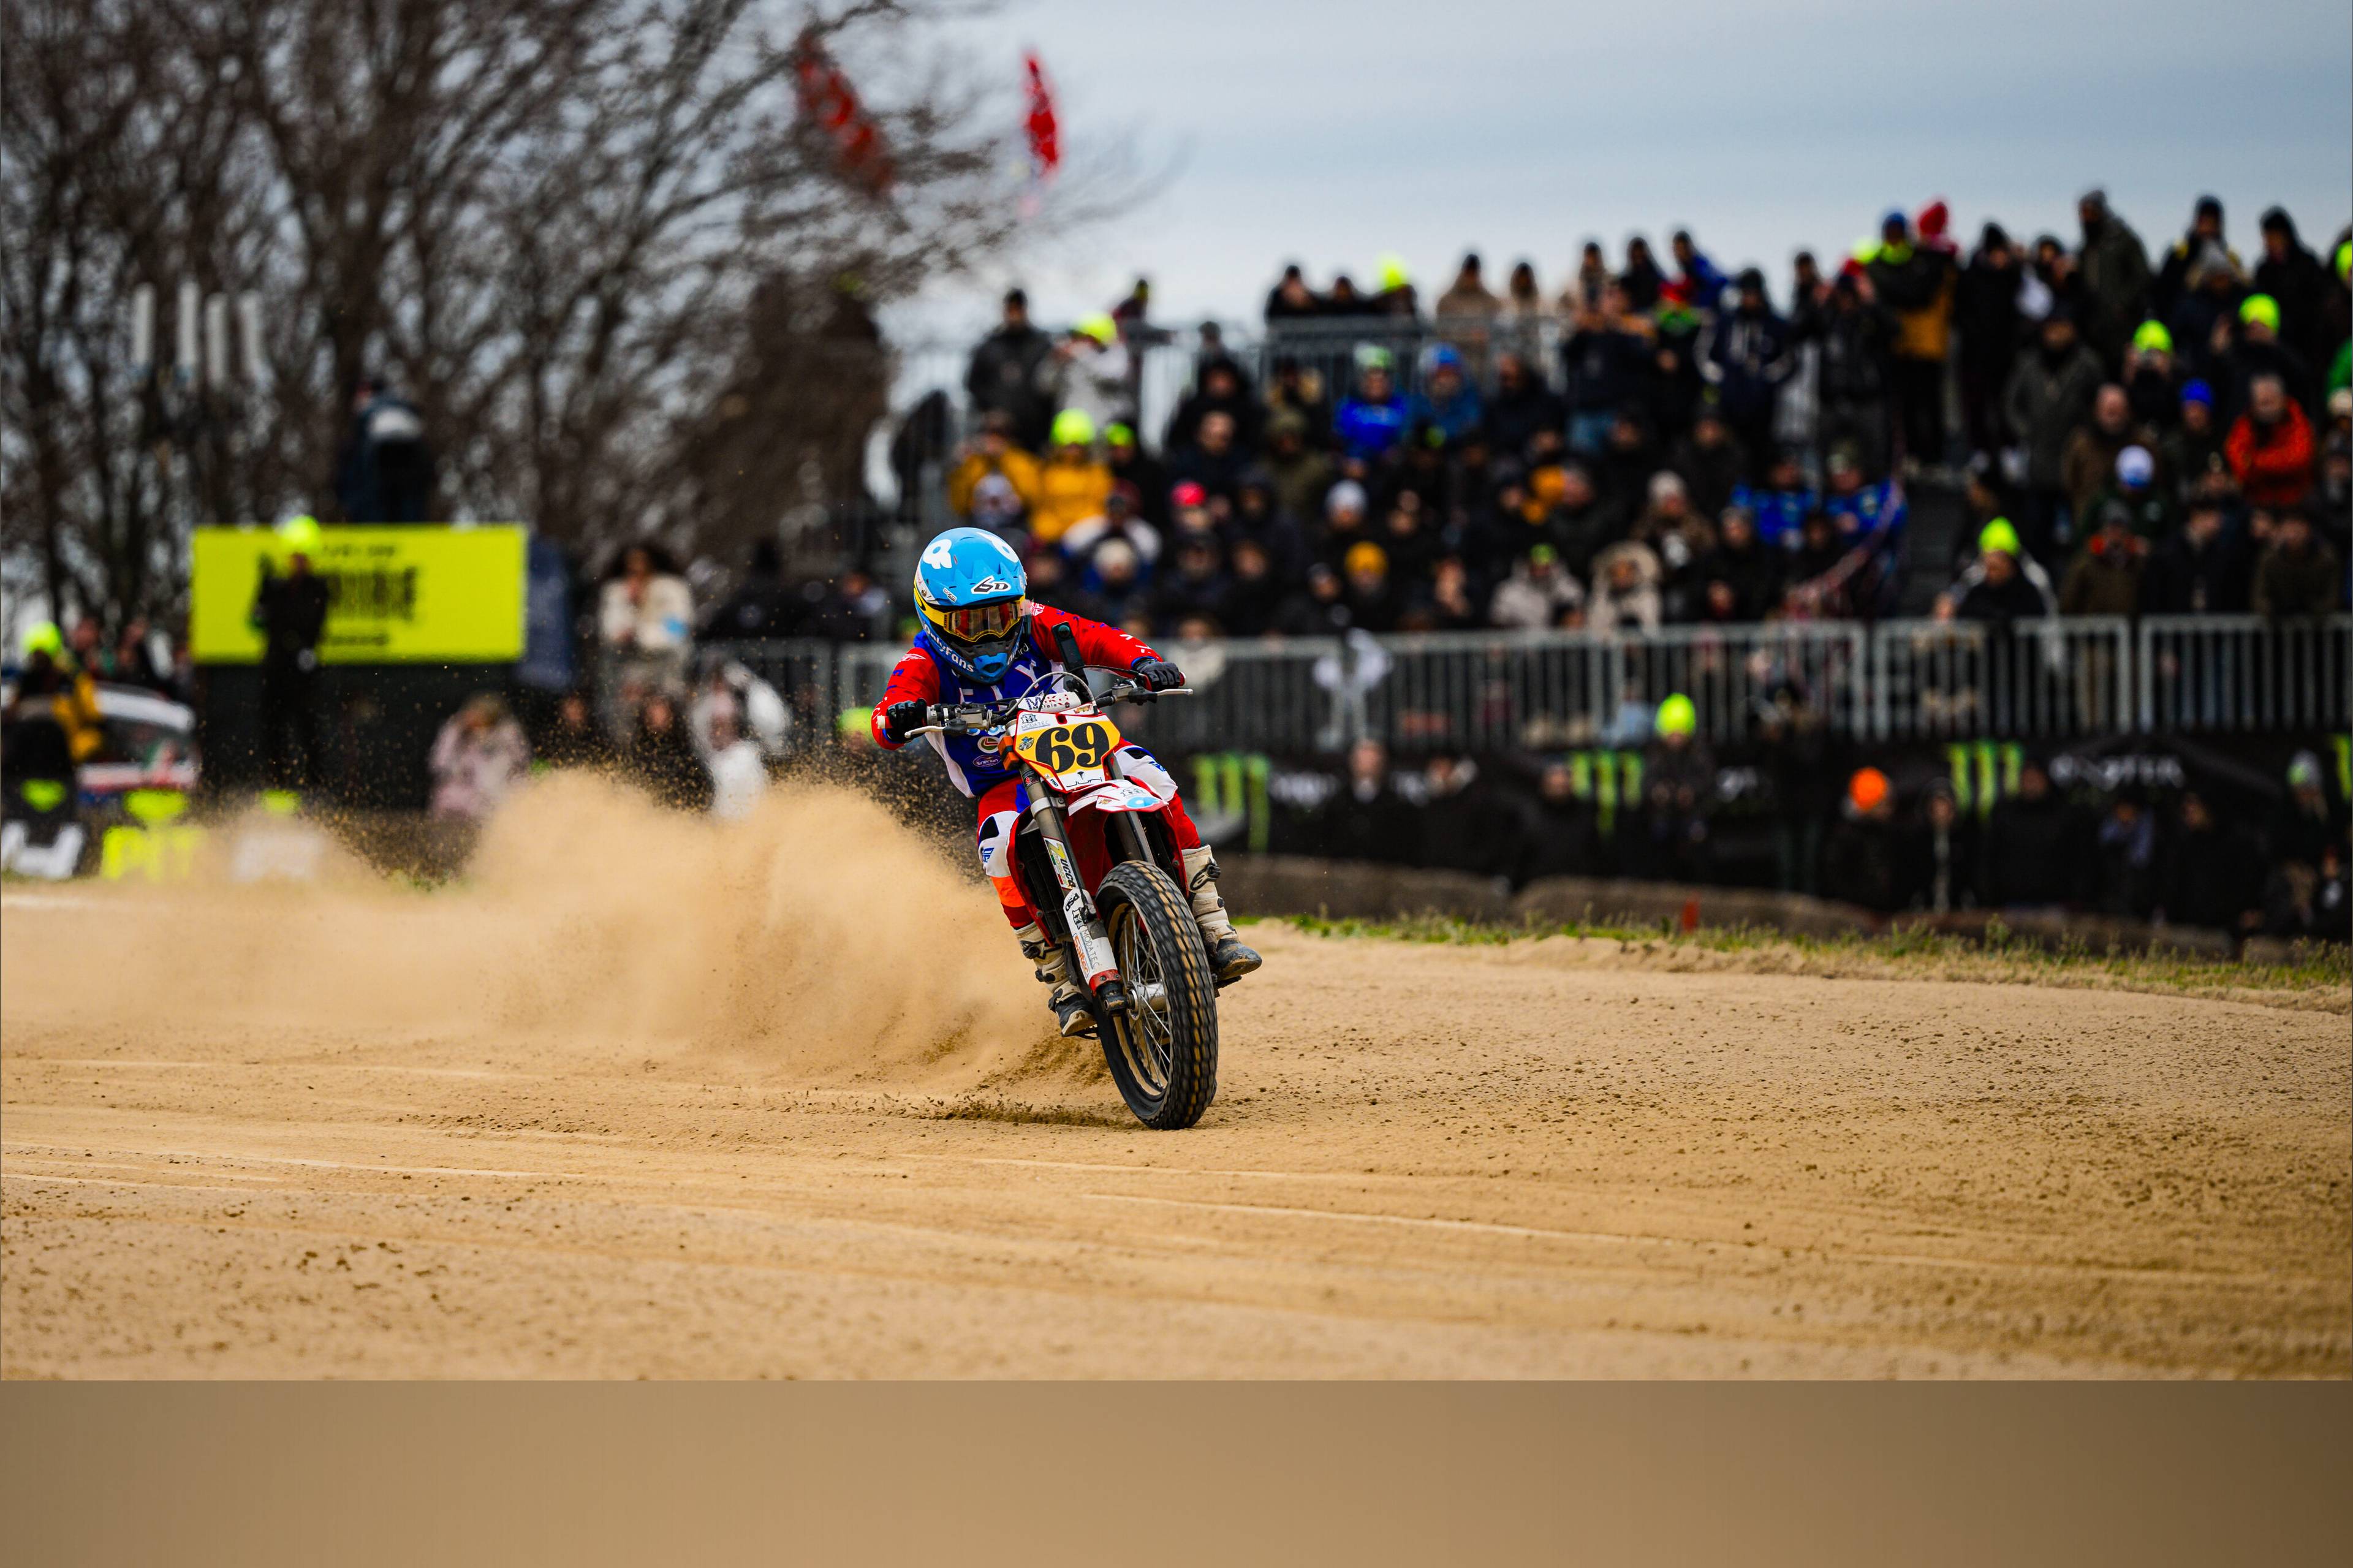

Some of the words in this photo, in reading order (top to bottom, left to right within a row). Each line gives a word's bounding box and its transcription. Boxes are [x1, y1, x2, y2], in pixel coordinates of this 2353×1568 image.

[923, 624, 975, 673] OnlyFans
[1021, 719, 1051, 730] MODATEC
[1036, 722, 1110, 773] 69
[1082, 928, 1101, 969] MODATEC
